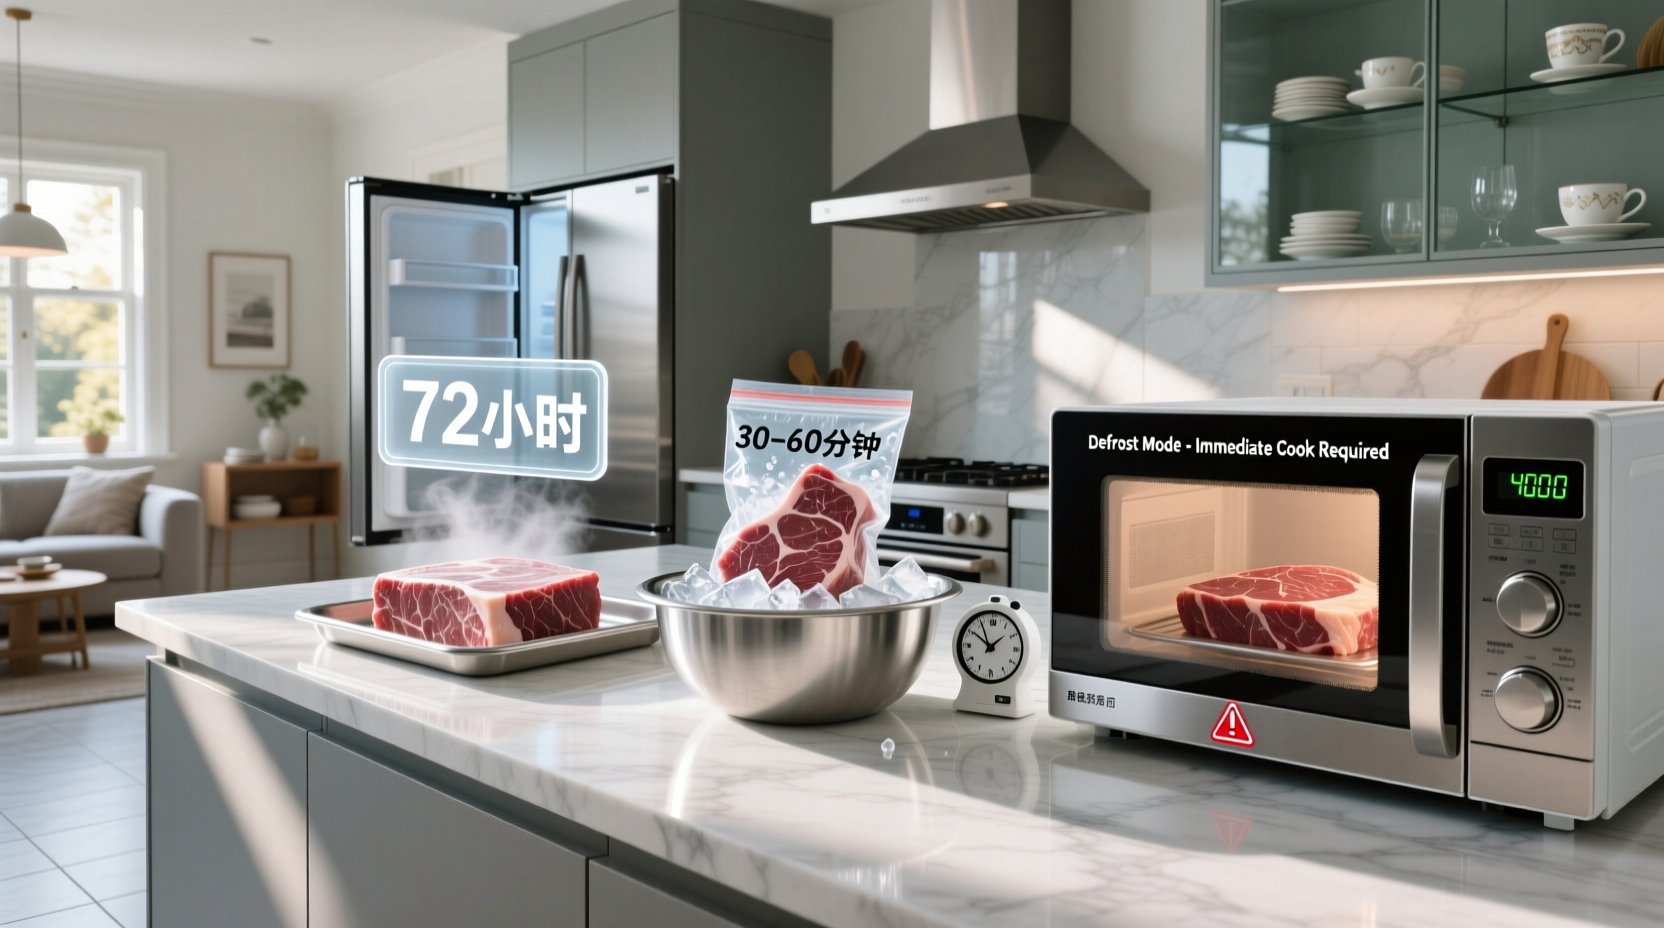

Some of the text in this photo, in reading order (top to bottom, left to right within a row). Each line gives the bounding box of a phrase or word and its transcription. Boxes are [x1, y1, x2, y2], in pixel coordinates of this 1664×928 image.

[402, 379, 587, 454] 72小时
[1088, 433, 1139, 451] Defrost
[1142, 435, 1182, 453] Mode
[1195, 436, 1273, 457] Immediate
[1276, 438, 1316, 458] Cook
[1318, 440, 1390, 464] Required
[1510, 472, 1568, 500] 4000
